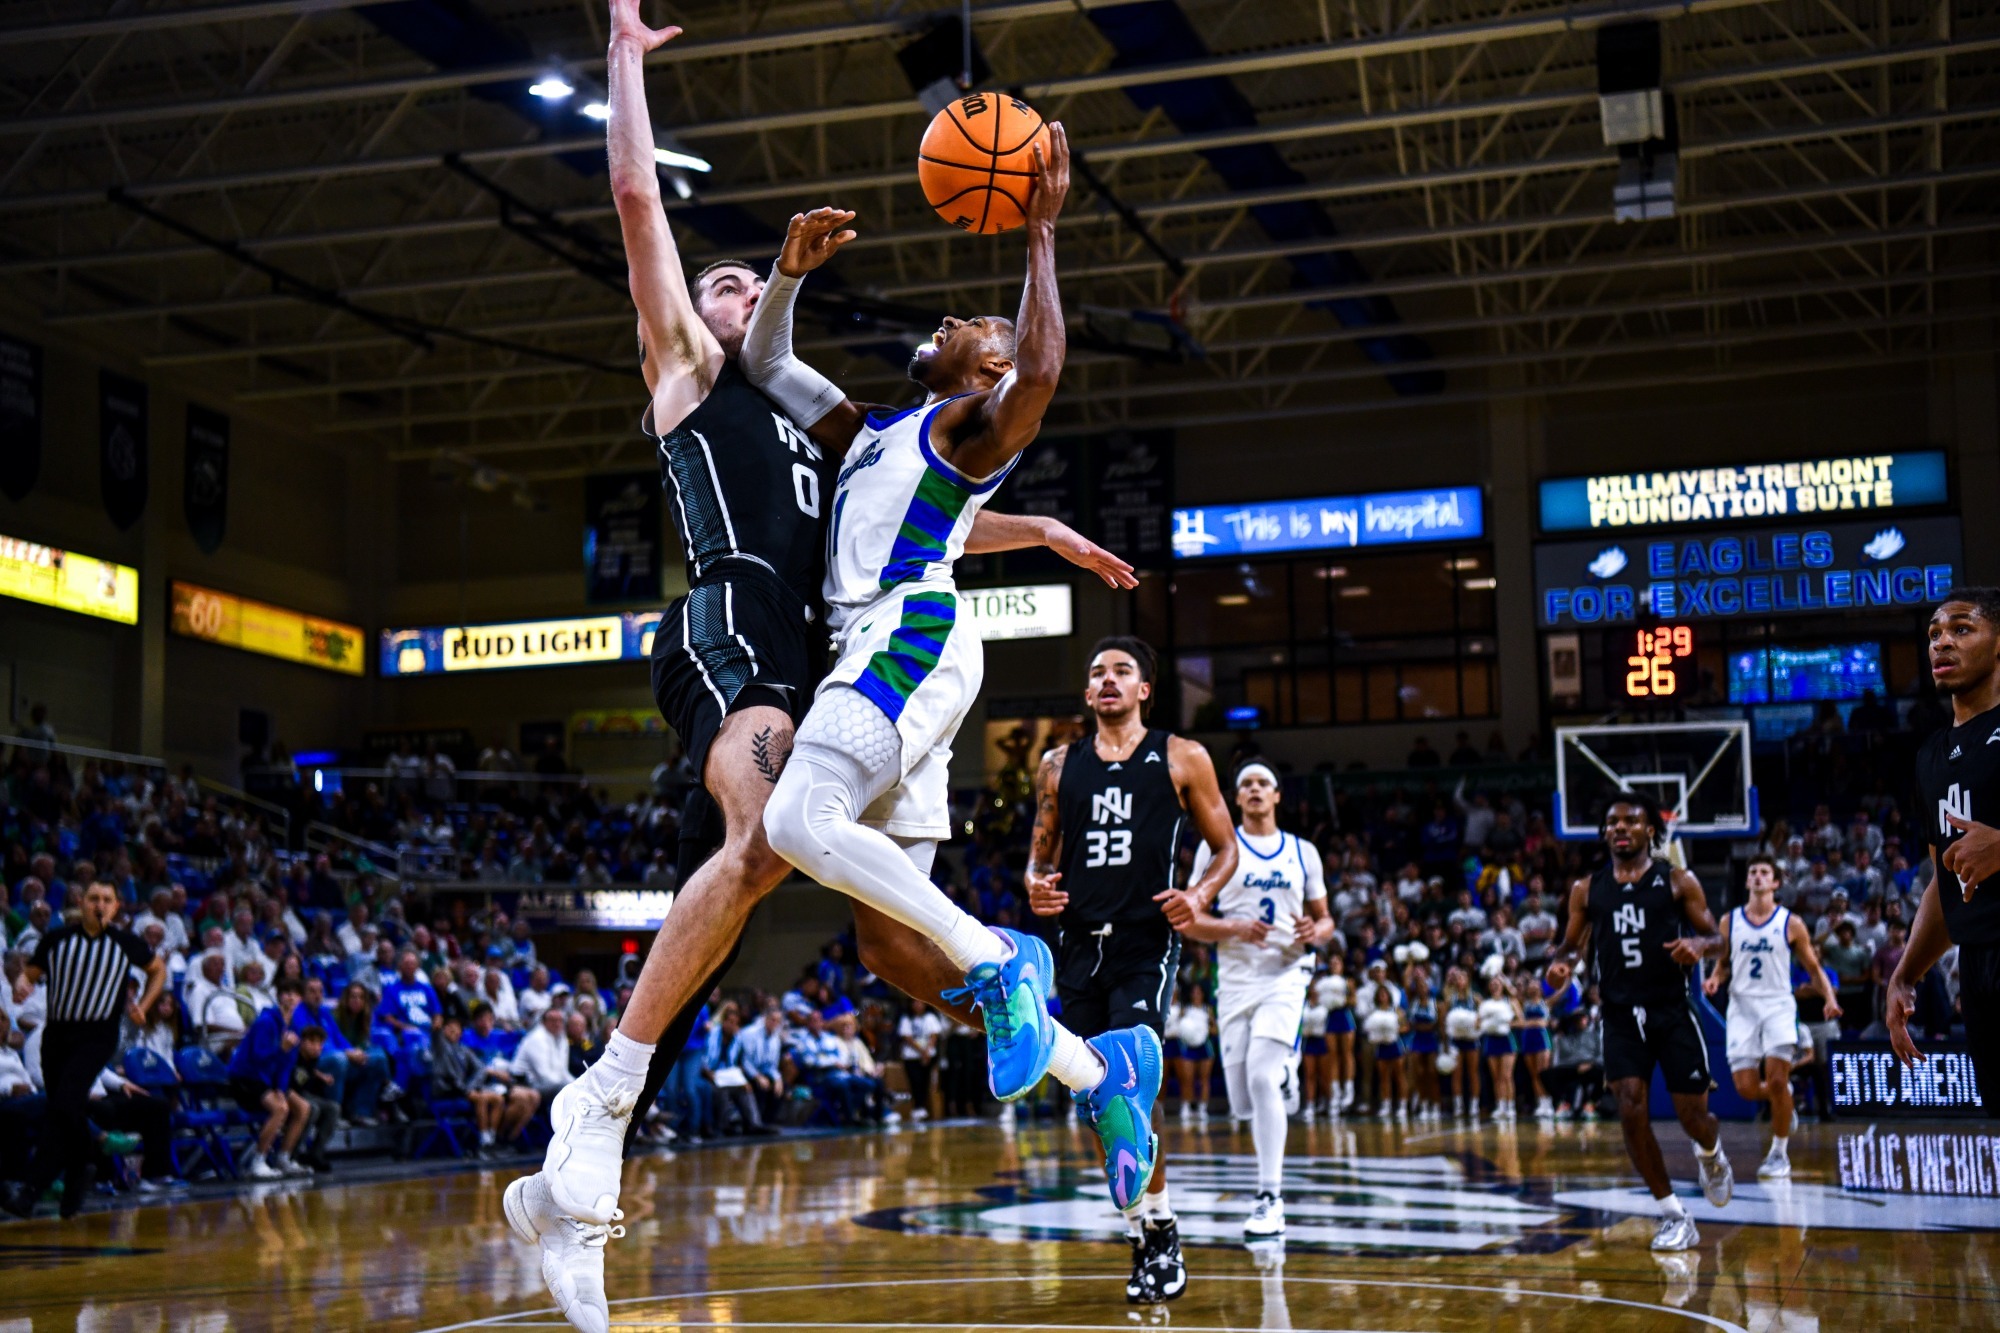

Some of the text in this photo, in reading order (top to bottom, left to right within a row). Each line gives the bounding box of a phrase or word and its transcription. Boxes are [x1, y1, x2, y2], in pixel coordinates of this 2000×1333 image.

[792, 462, 820, 519] 0
[1590, 480, 1894, 528] FOUNDATION SUITE
[1223, 510, 1281, 541] This
[1319, 508, 1358, 546] my
[1647, 530, 1834, 579] EAGLES
[973, 592, 1036, 618] TORS
[1544, 563, 1954, 624] FOR EXCELLENCE
[189, 591, 222, 635] 60
[453, 628, 611, 660] BUD LIGHT
[1637, 626, 1692, 656] 1:29
[1626, 655, 1676, 696] 26
[1086, 829, 1132, 868] 33
[1243, 870, 1291, 892] Eagles
[1259, 897, 1275, 925] 3
[1621, 937, 1643, 969] 5
[1750, 957, 1762, 979] 2
